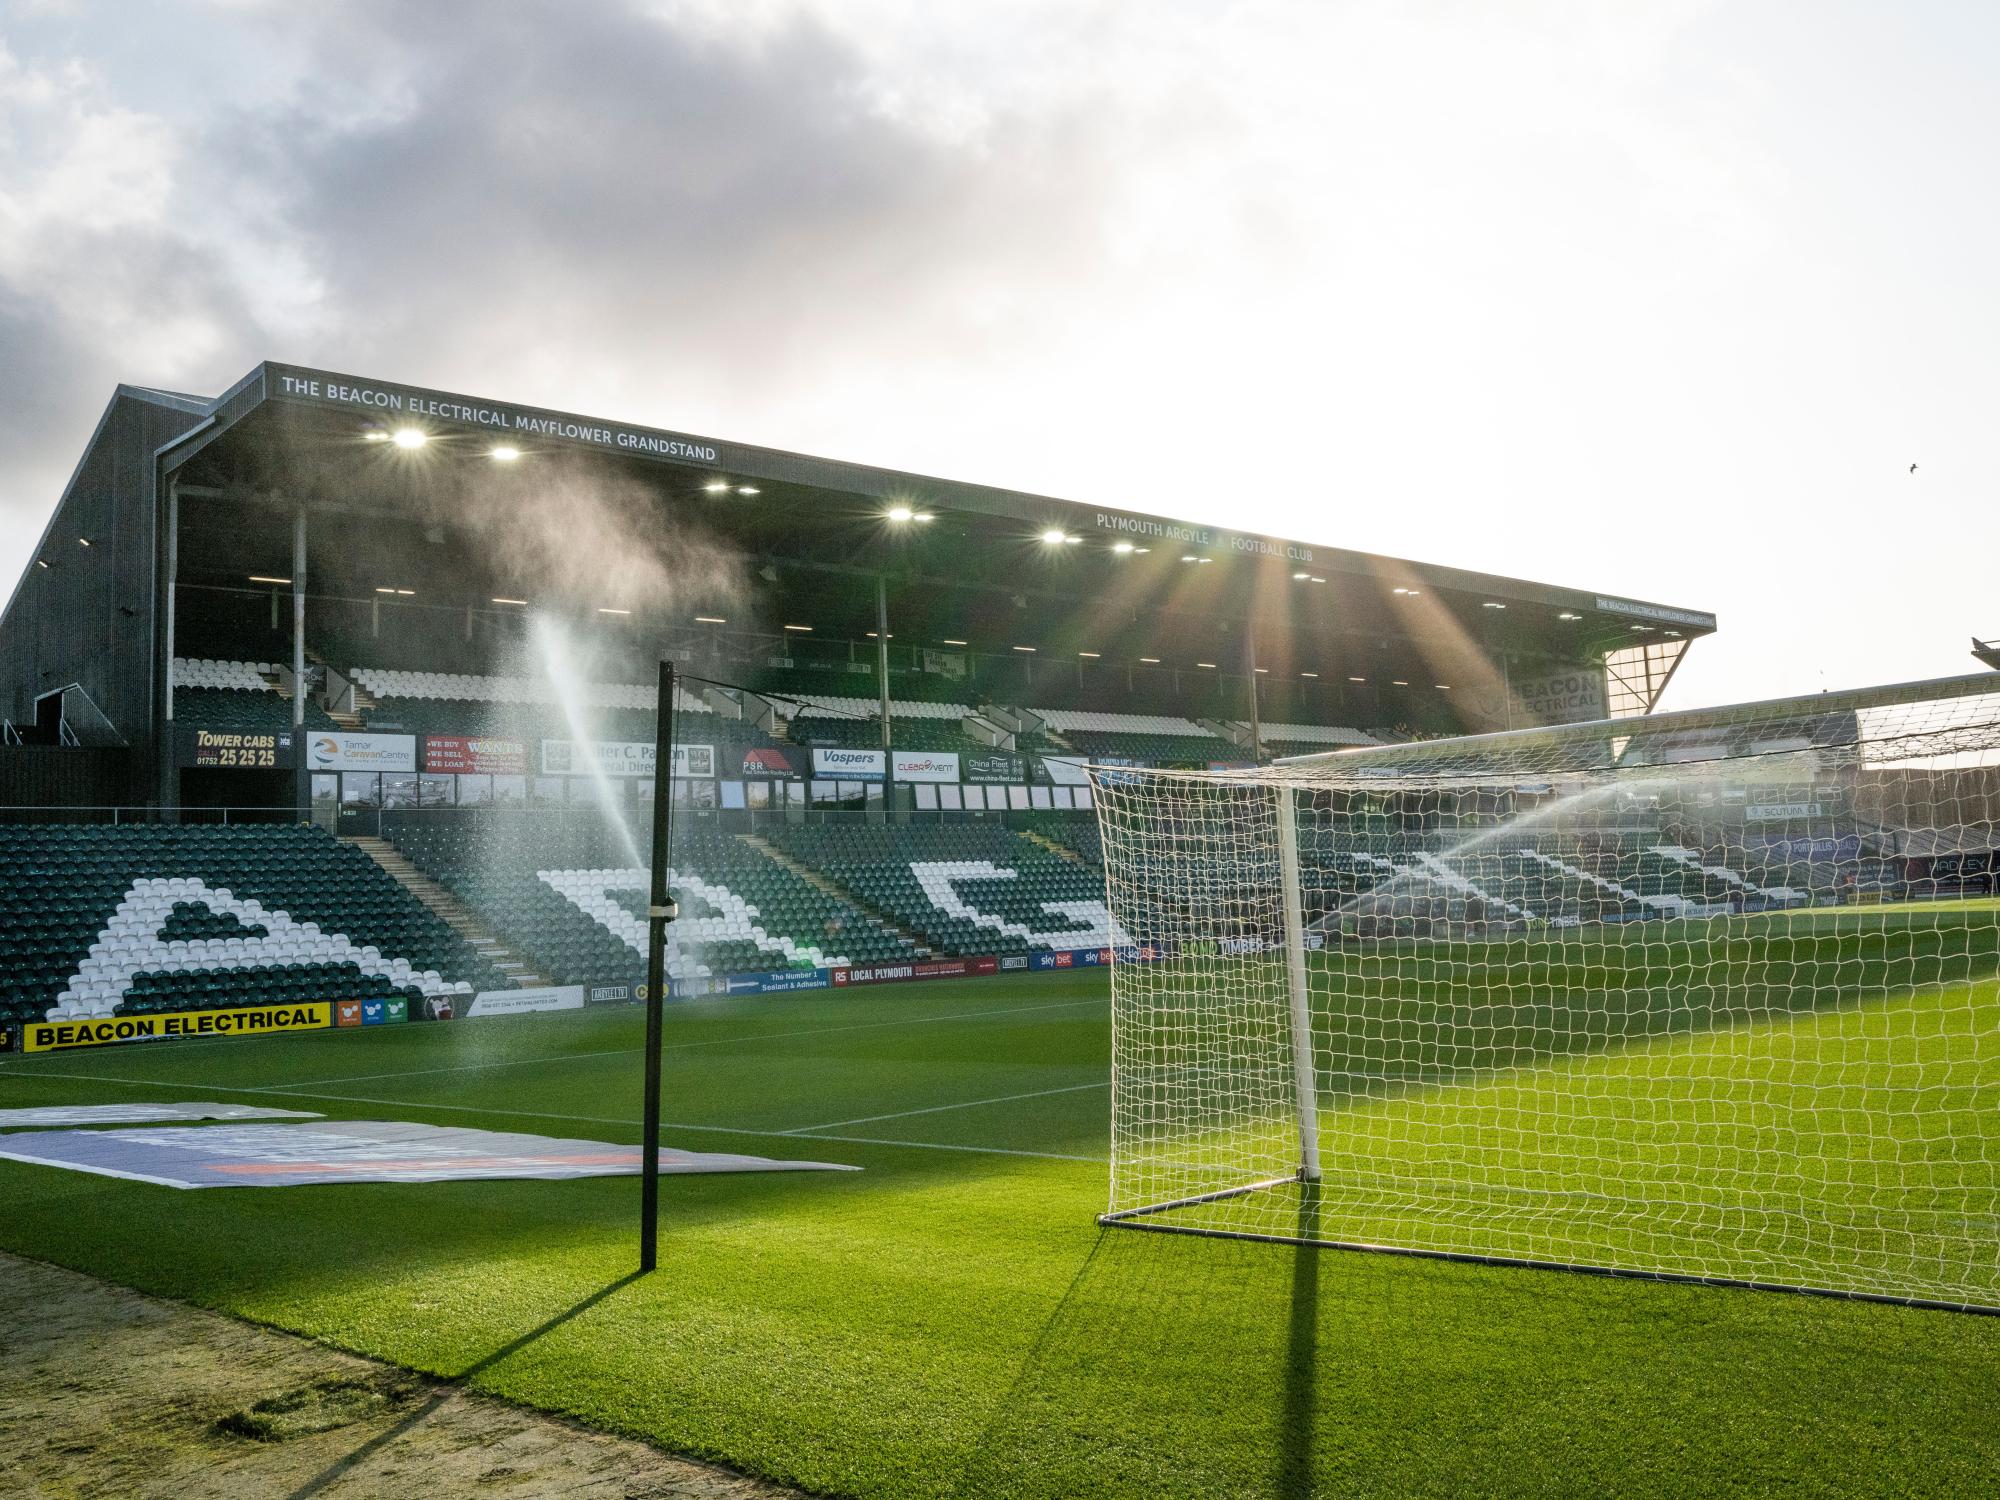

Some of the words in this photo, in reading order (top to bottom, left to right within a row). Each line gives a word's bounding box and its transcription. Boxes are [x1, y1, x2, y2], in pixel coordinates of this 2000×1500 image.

[282, 376, 320, 398] THE
[327, 383, 402, 410] BEACON
[408, 397, 510, 428] ELECTRICAL
[515, 415, 612, 444] MAYFLOWER
[617, 433, 717, 462] GRANDSTAND
[1097, 513, 1162, 537] PLYMOUTH
[1166, 525, 1209, 545] ARGYLE
[1231, 537, 1285, 558] FOOTBALL
[1287, 547, 1313, 562] CLUB
[197, 731, 242, 747] TOWER
[243, 735, 275, 748] CABS
[344, 740, 371, 749] Tamar
[197, 757, 218, 765] 01752
[220, 749, 237, 765] 25
[239, 749, 256, 765] 25
[258, 750, 275, 766] 25
[823, 750, 875, 764] Vospers
[969, 759, 989, 768] China
[991, 760, 1008, 768] Fleet
[743, 761, 763, 770] PSR
[1218, 937, 1263, 953] TIMBER
[1041, 955, 1055, 967] sky
[1057, 954, 1071, 964] bet
[1085, 952, 1098, 964] sky
[786, 971, 811, 980] Number
[850, 968, 873, 981] LOCAL
[875, 966, 912, 979] PLYMOUTH
[762, 983, 788, 991] Sealant
[797, 980, 827, 988] Adhesive
[594, 989, 615, 999] ARGYLE
[618, 988, 625, 997] TV
[36, 1020, 155, 1046] BEACON
[164, 1009, 321, 1034] ELECTRICAL
